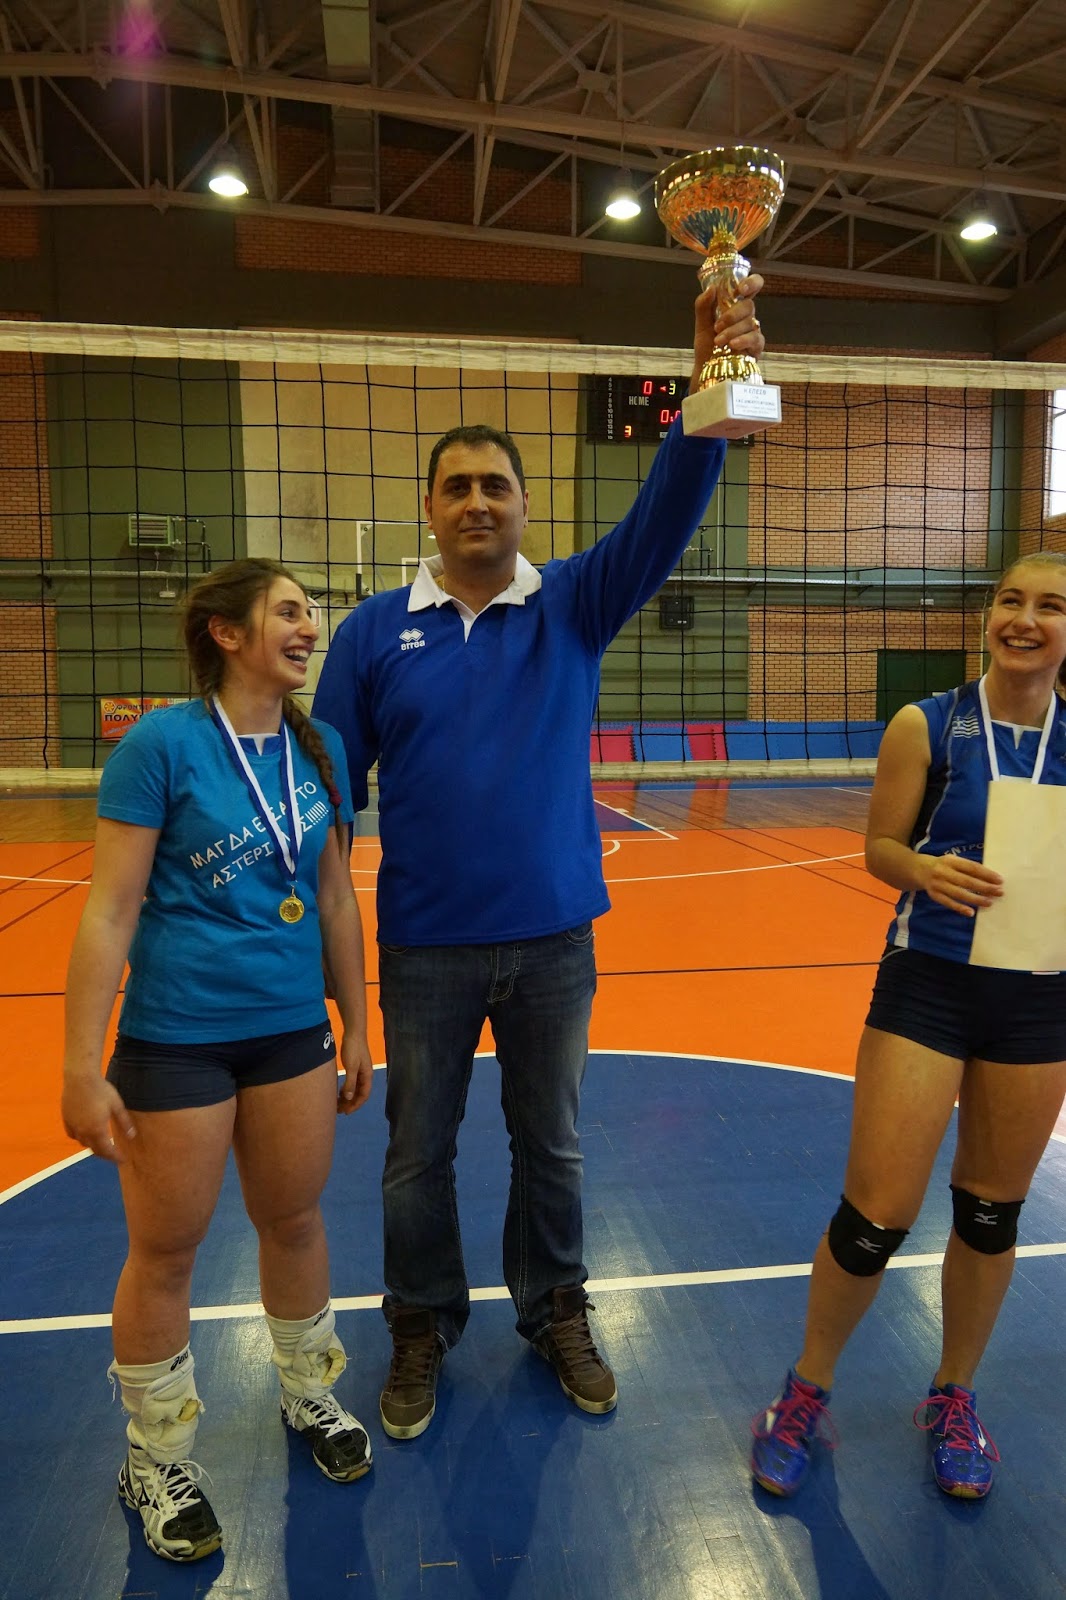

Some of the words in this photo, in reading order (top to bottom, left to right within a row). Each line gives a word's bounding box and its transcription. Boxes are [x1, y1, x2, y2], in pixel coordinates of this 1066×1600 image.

[643, 381, 653, 395] 0
[668, 383, 676, 395] 3
[624, 425, 632, 437] 3
[104, 714, 142, 722] ΠΟΛΥ
[190, 826, 254, 869] ΜΑΓΔΑ
[294, 781, 317, 799] ΤΟ
[212, 841, 274, 888] ΑΣΤΕΡΙ
